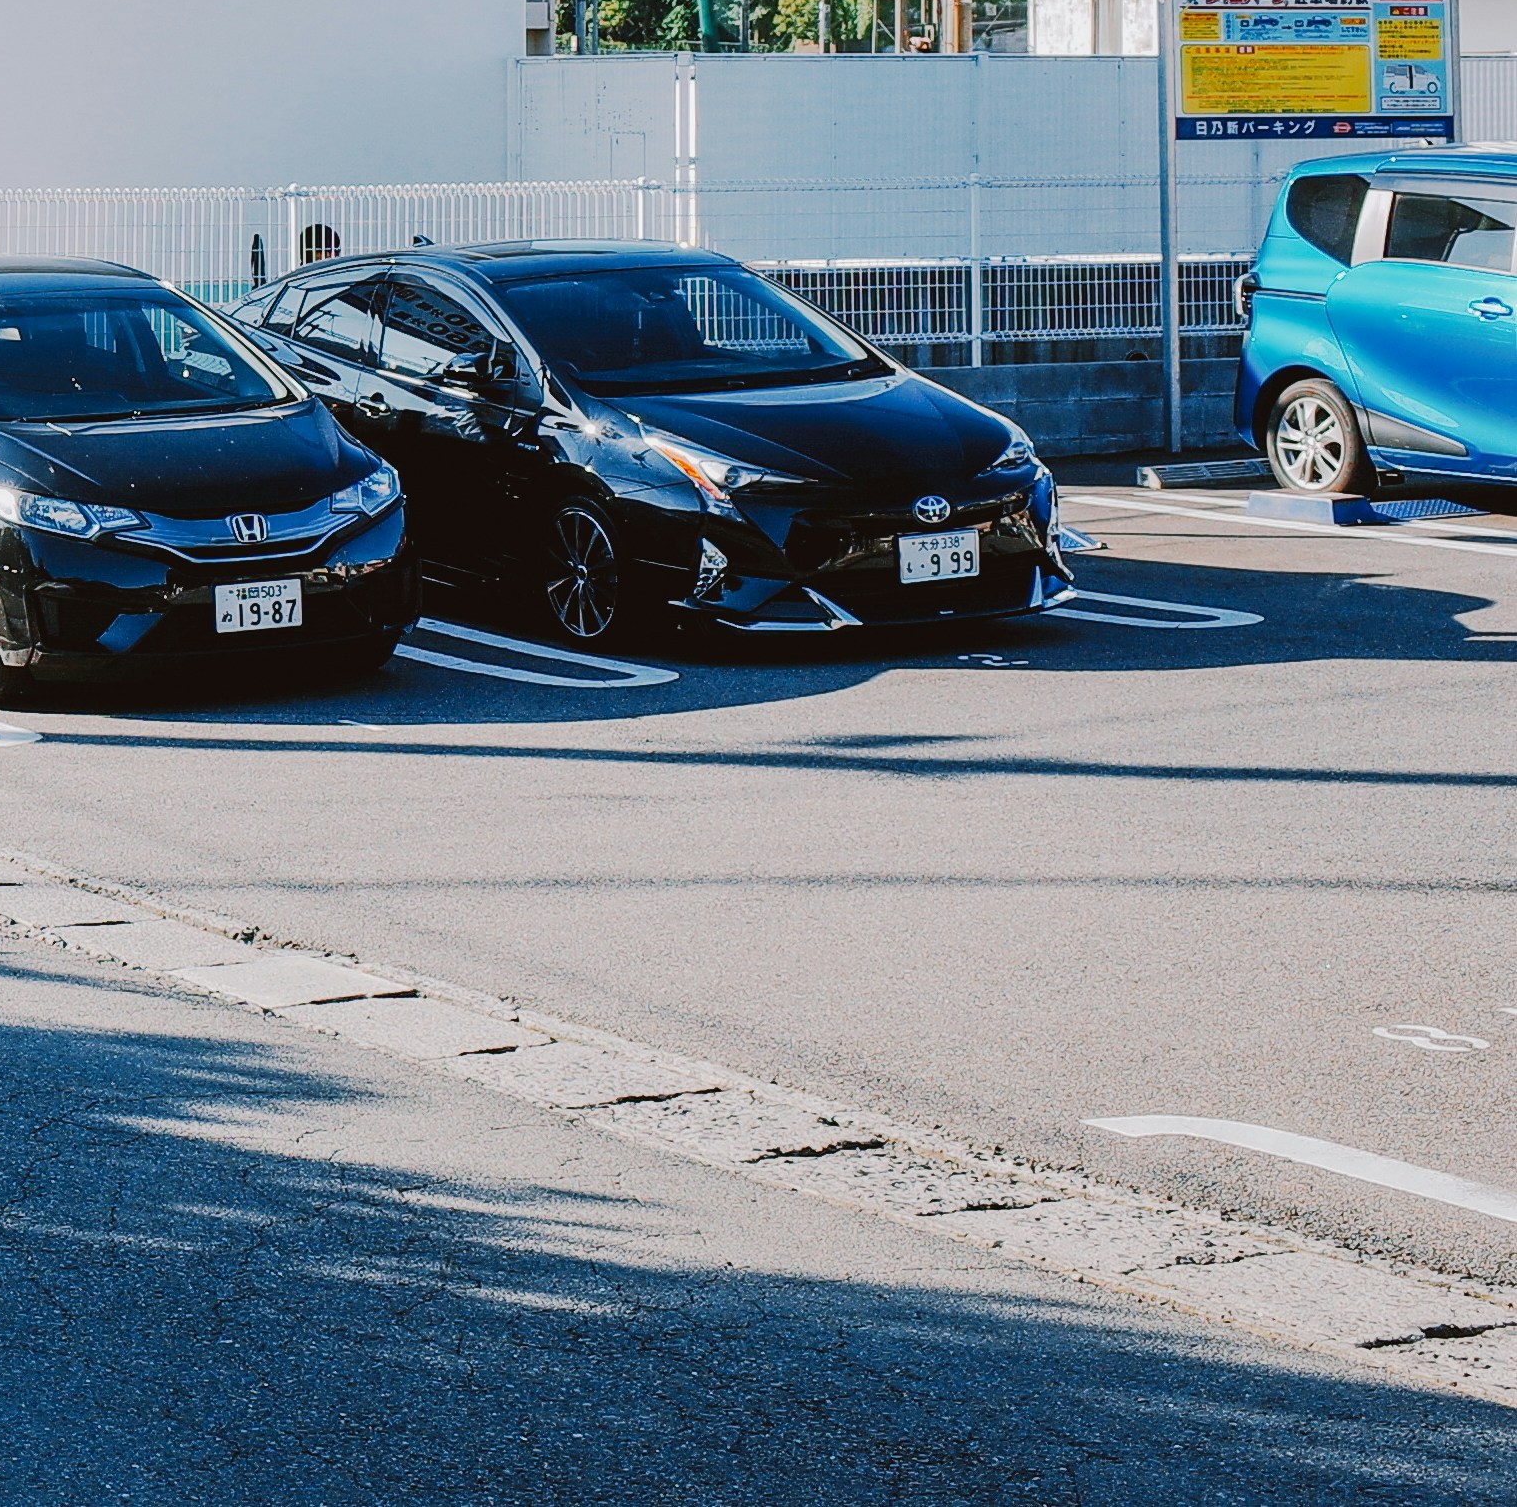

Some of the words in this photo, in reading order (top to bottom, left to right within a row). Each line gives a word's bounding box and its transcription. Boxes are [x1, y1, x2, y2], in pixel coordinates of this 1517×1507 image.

[1195, 120, 1316, 135] 日乃新パーキング
[238, 598, 297, 627] 19-87
